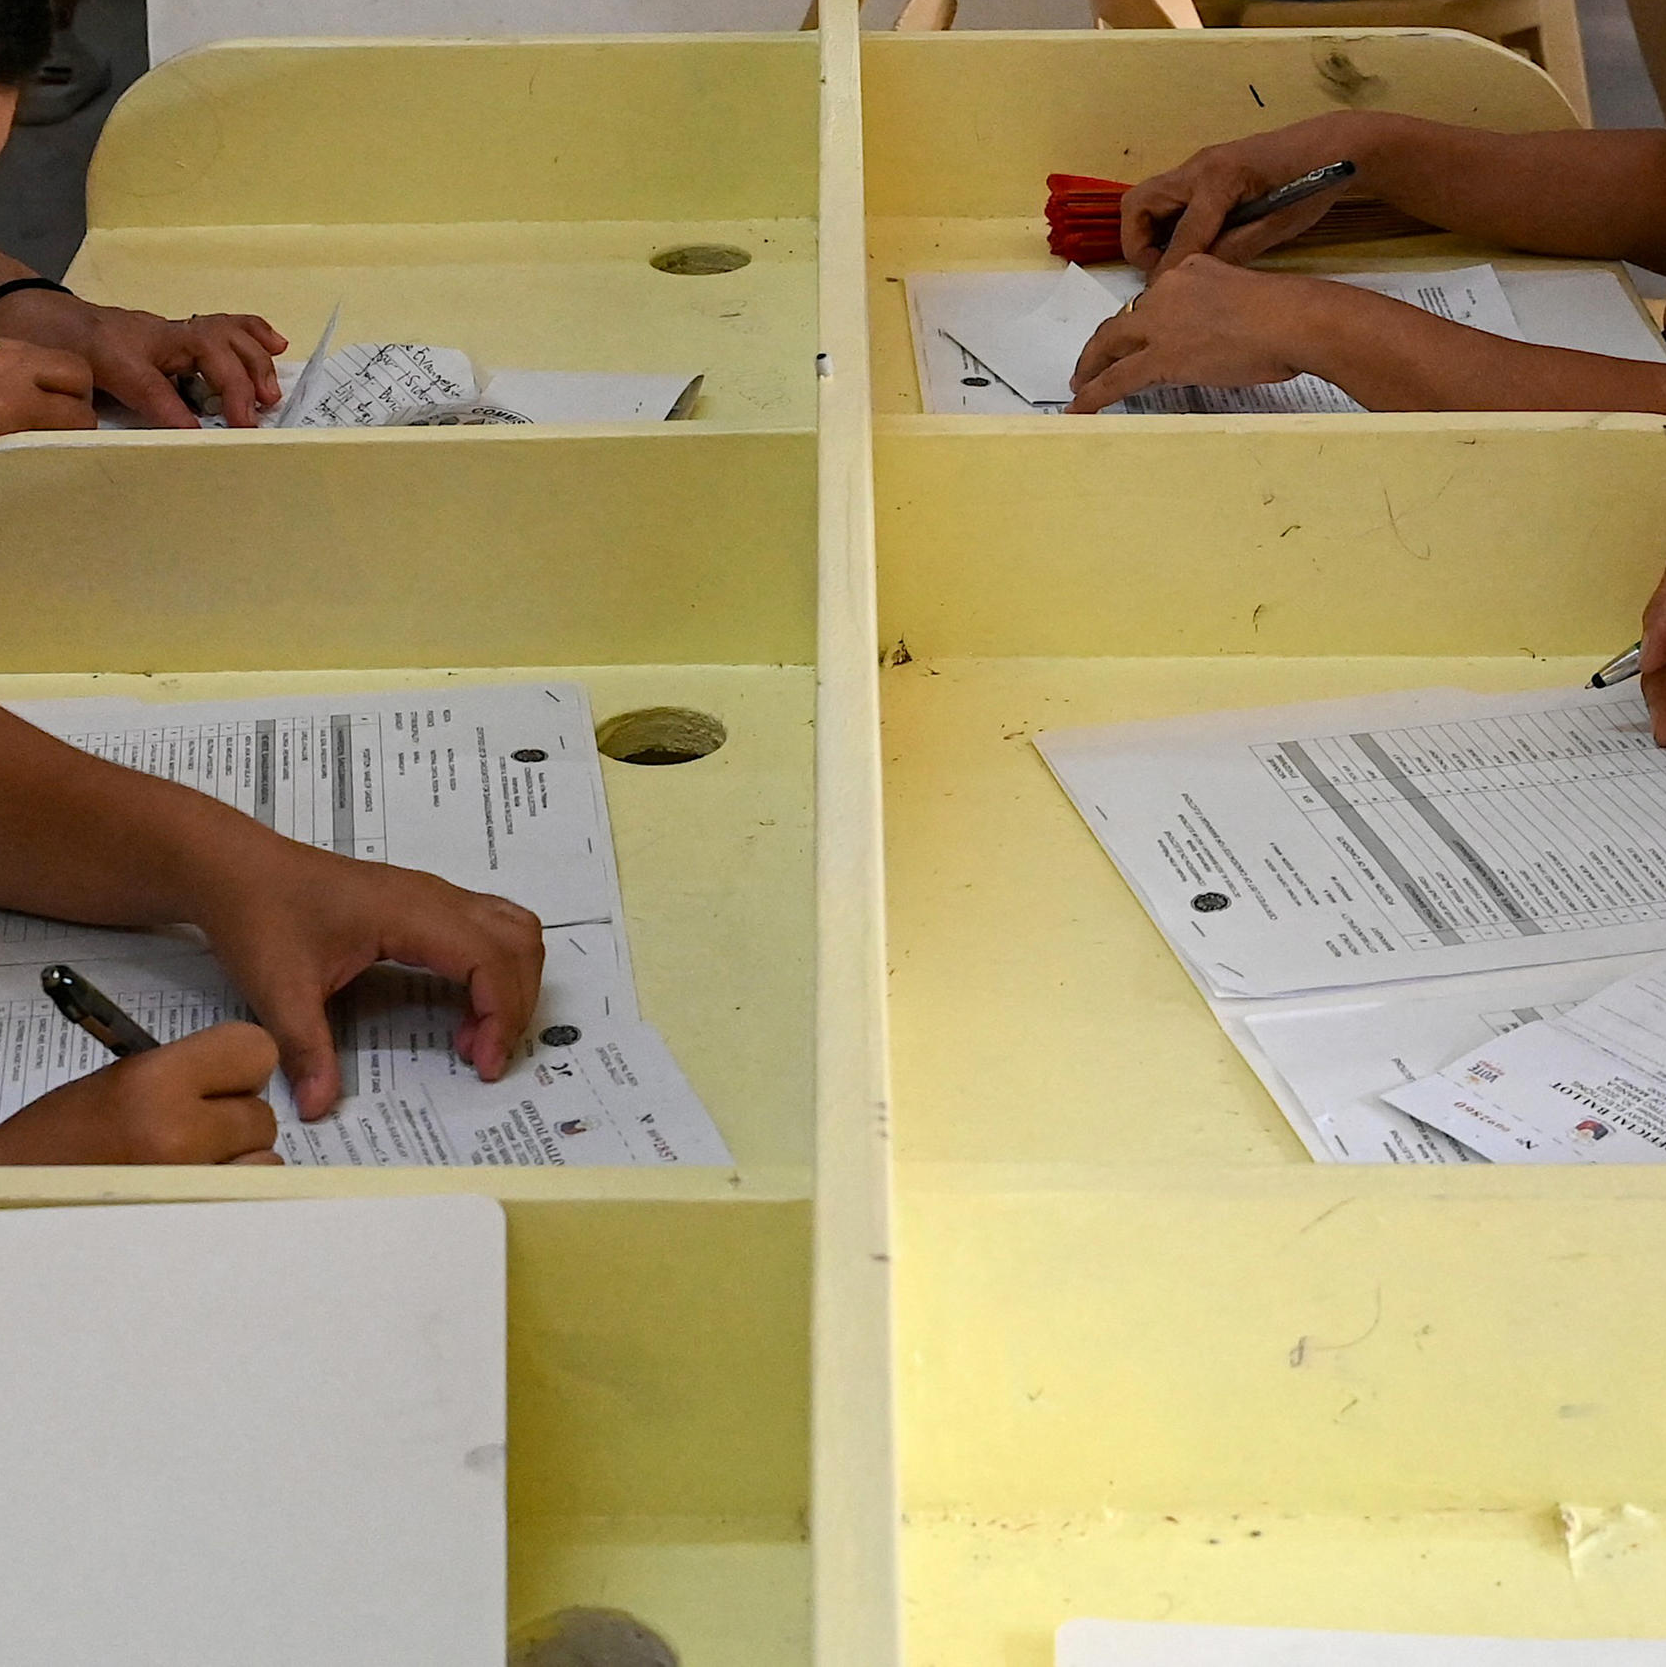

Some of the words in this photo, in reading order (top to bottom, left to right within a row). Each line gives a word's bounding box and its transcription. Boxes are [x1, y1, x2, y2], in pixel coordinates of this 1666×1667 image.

[1467, 1063, 1498, 1083] VOTE
[1613, 1076, 1649, 1097] MANILA
[1551, 1082, 1609, 1115] BALLOT
[1571, 1080, 1626, 1112] ELECTIONS
[1606, 1080, 1642, 1102] MANILA
[520, 1100, 550, 1138] OFFICIAL
